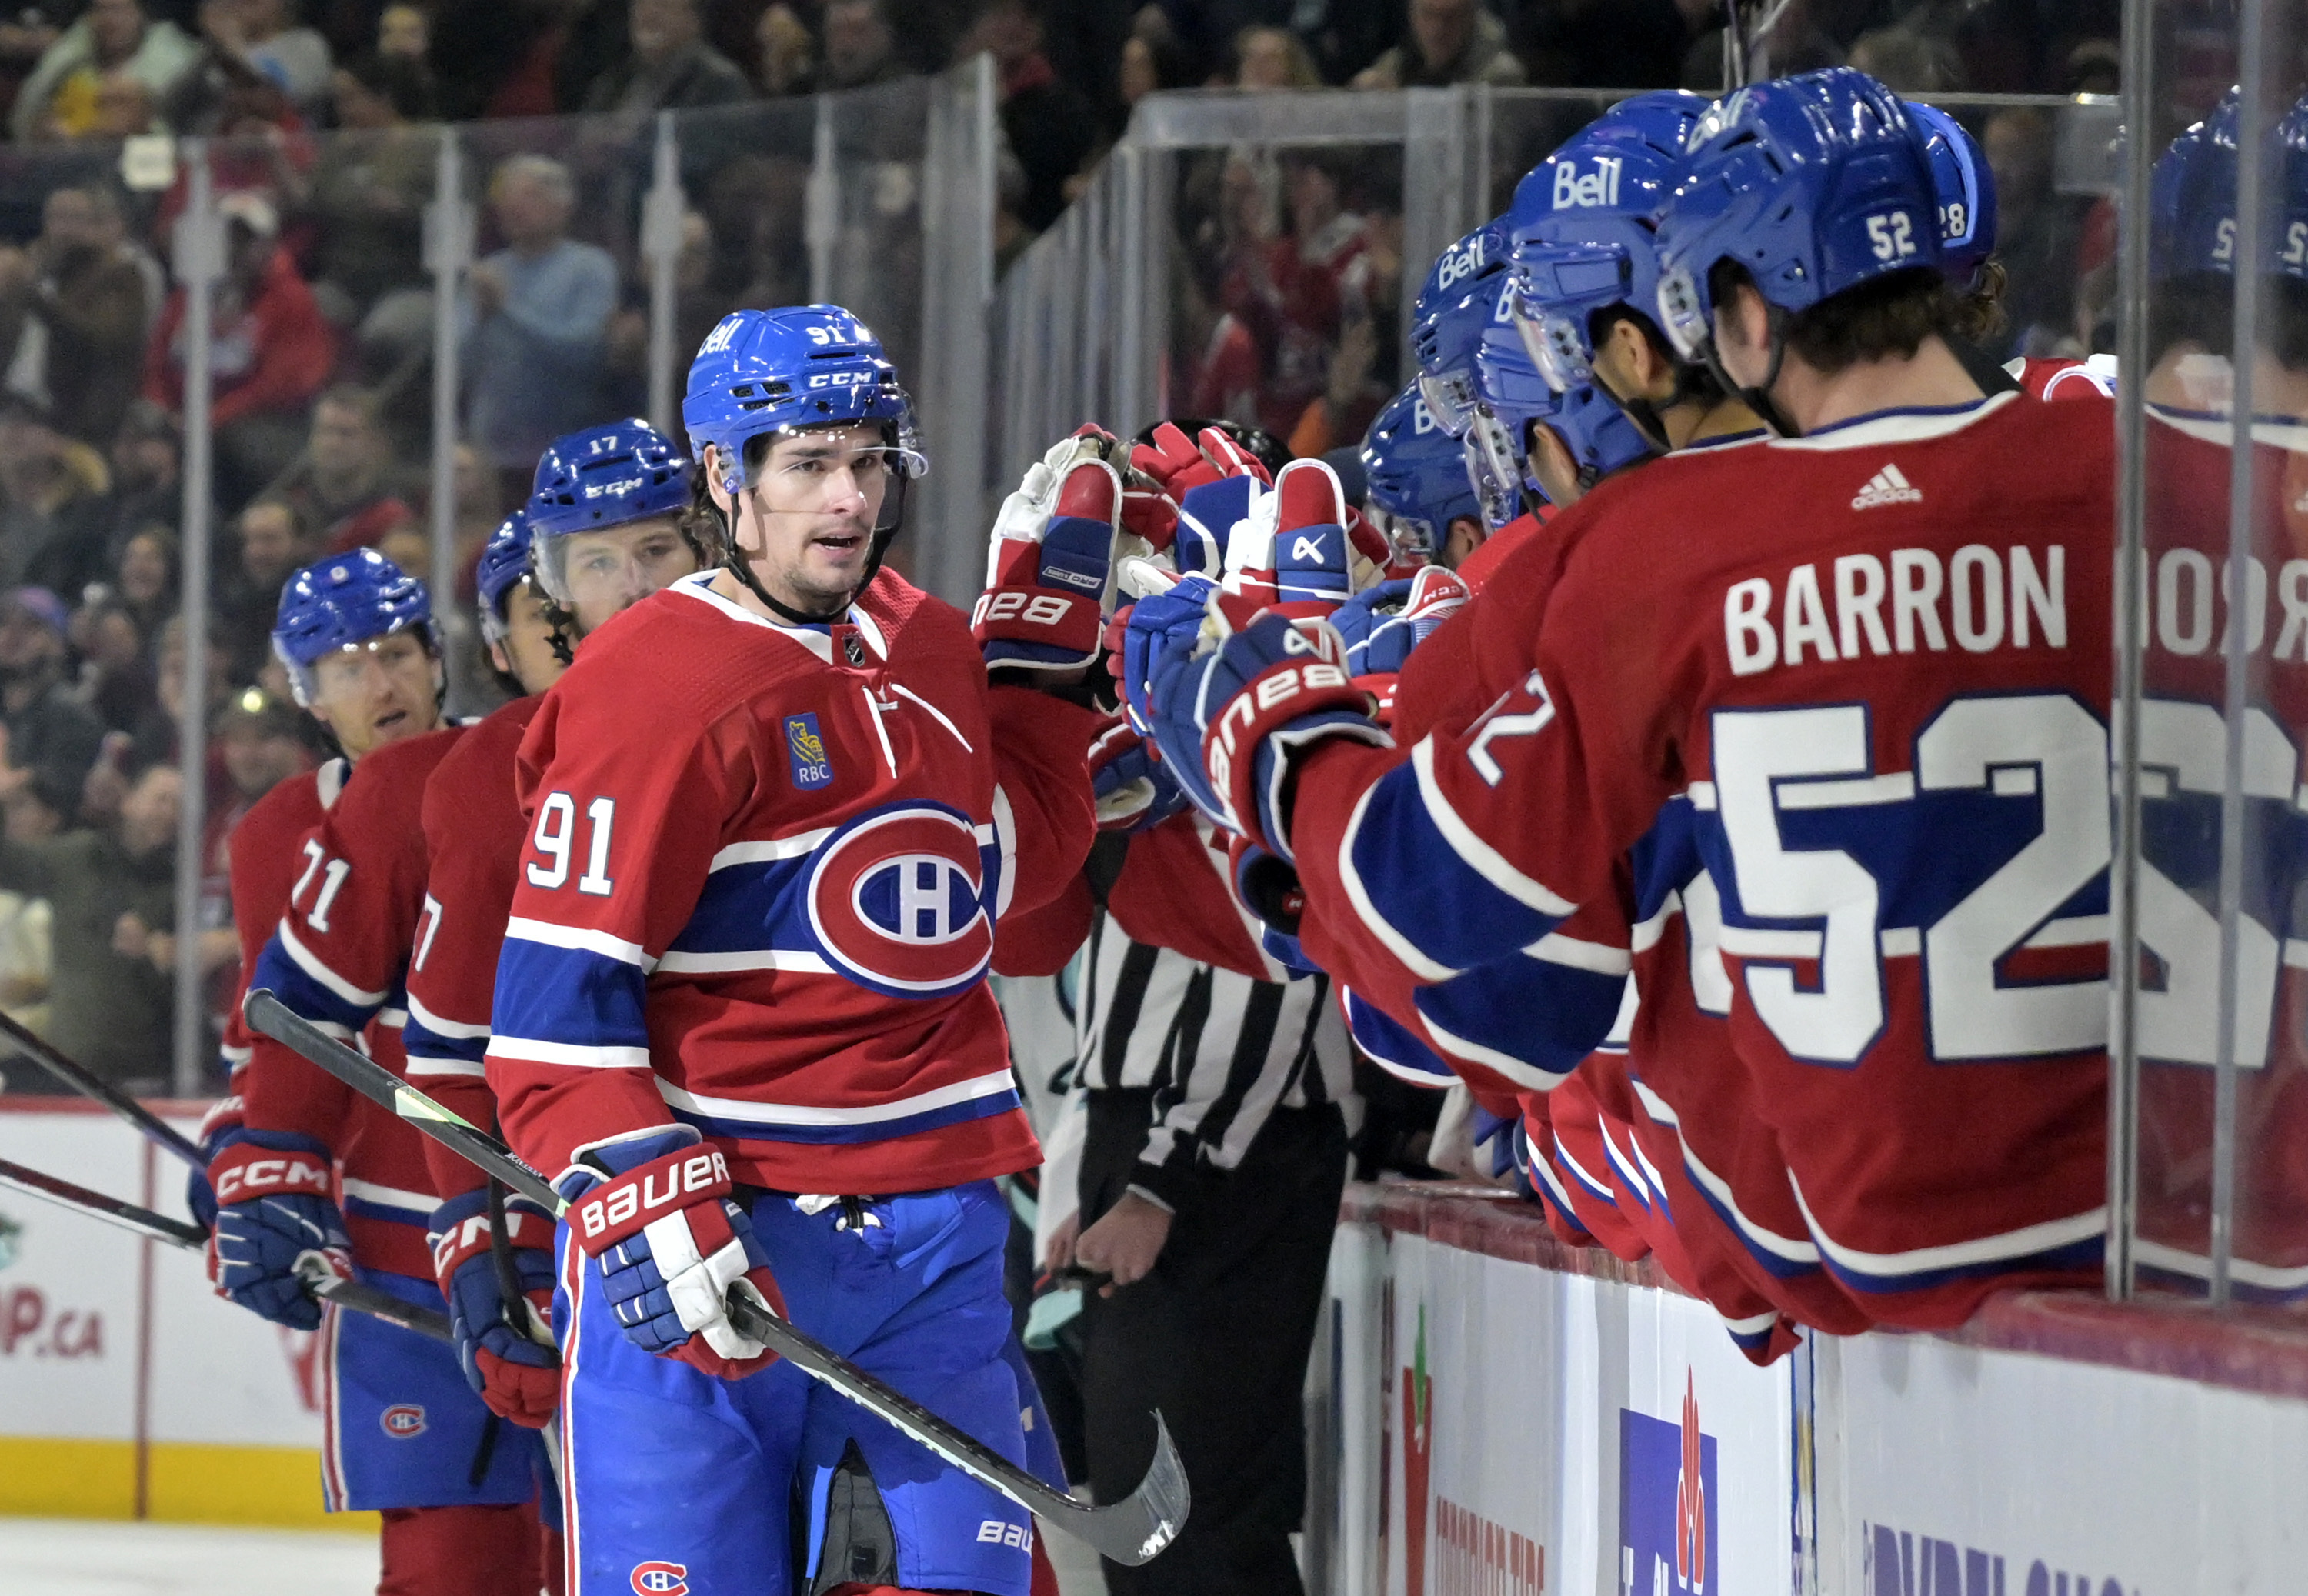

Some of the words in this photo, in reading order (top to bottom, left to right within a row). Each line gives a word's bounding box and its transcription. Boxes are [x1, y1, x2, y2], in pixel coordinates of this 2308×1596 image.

[1553, 157, 1623, 210] Bell
[1867, 211, 1916, 261] 52
[1439, 234, 1485, 291] Bell
[808, 325, 846, 345] 91
[809, 372, 872, 388] CCM
[589, 435, 618, 455] 17
[1851, 488, 1923, 510] adidas
[1723, 544, 2069, 676] BARRON
[799, 765, 829, 783] RBC
[526, 791, 616, 898] 91
[1712, 691, 2112, 1071] 52
[216, 1160, 328, 1198] CCM
